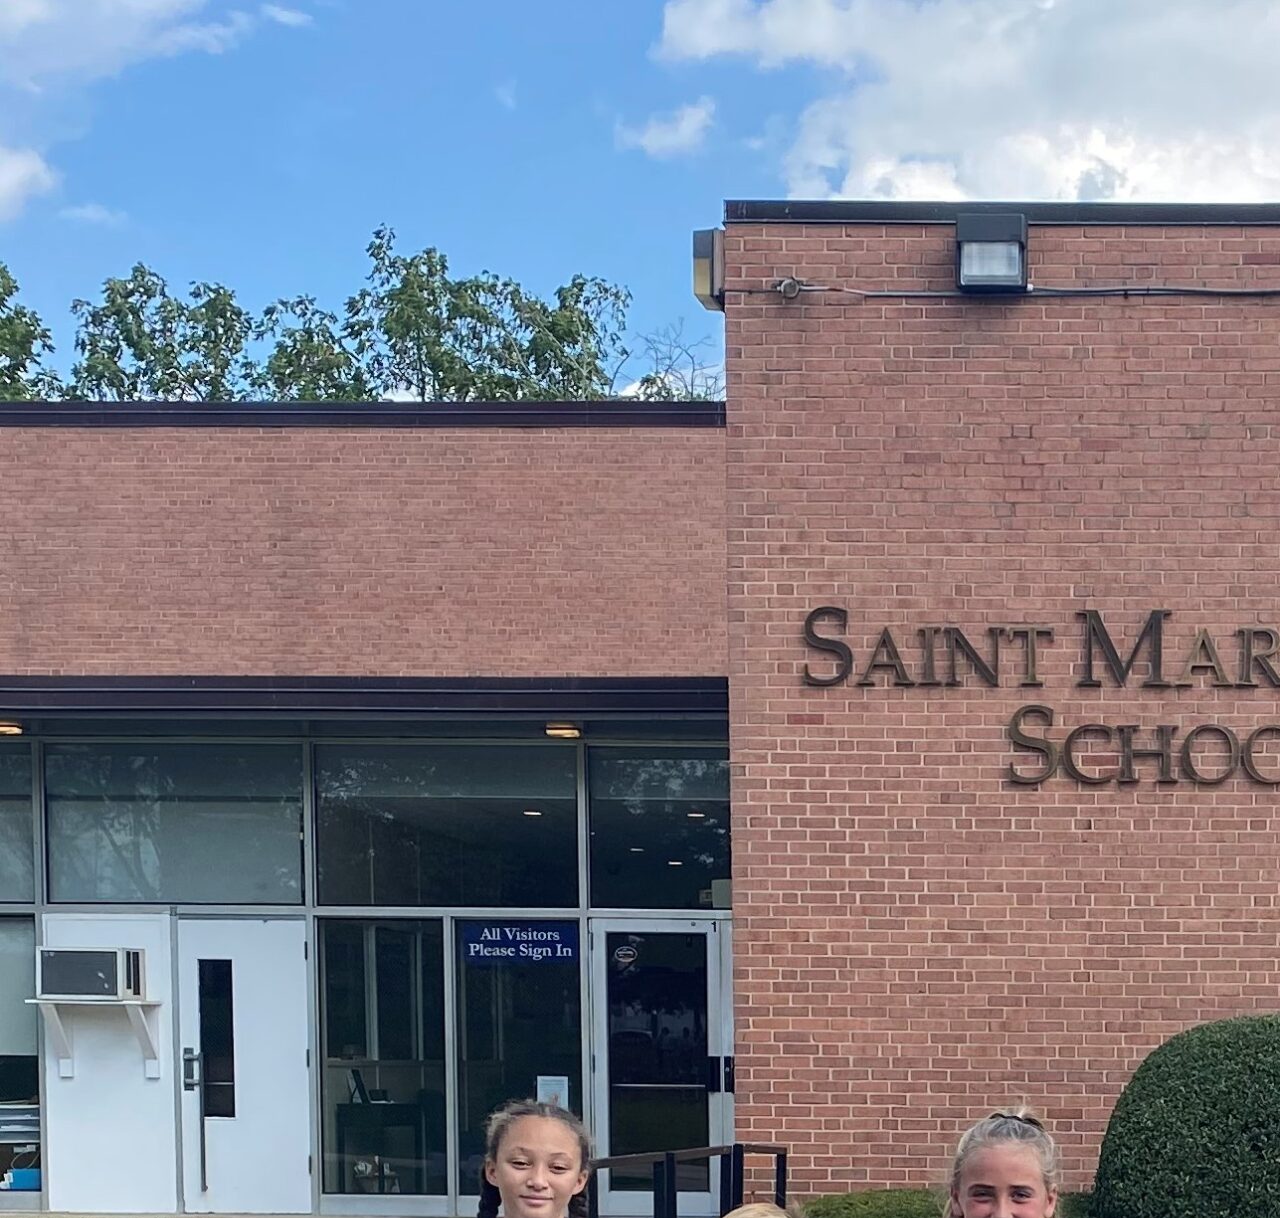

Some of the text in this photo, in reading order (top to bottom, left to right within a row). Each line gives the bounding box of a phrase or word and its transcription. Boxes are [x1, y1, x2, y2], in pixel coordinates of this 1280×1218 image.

[480, 927, 560, 941] All Visitors
[468, 943, 573, 961] Please Sign In
